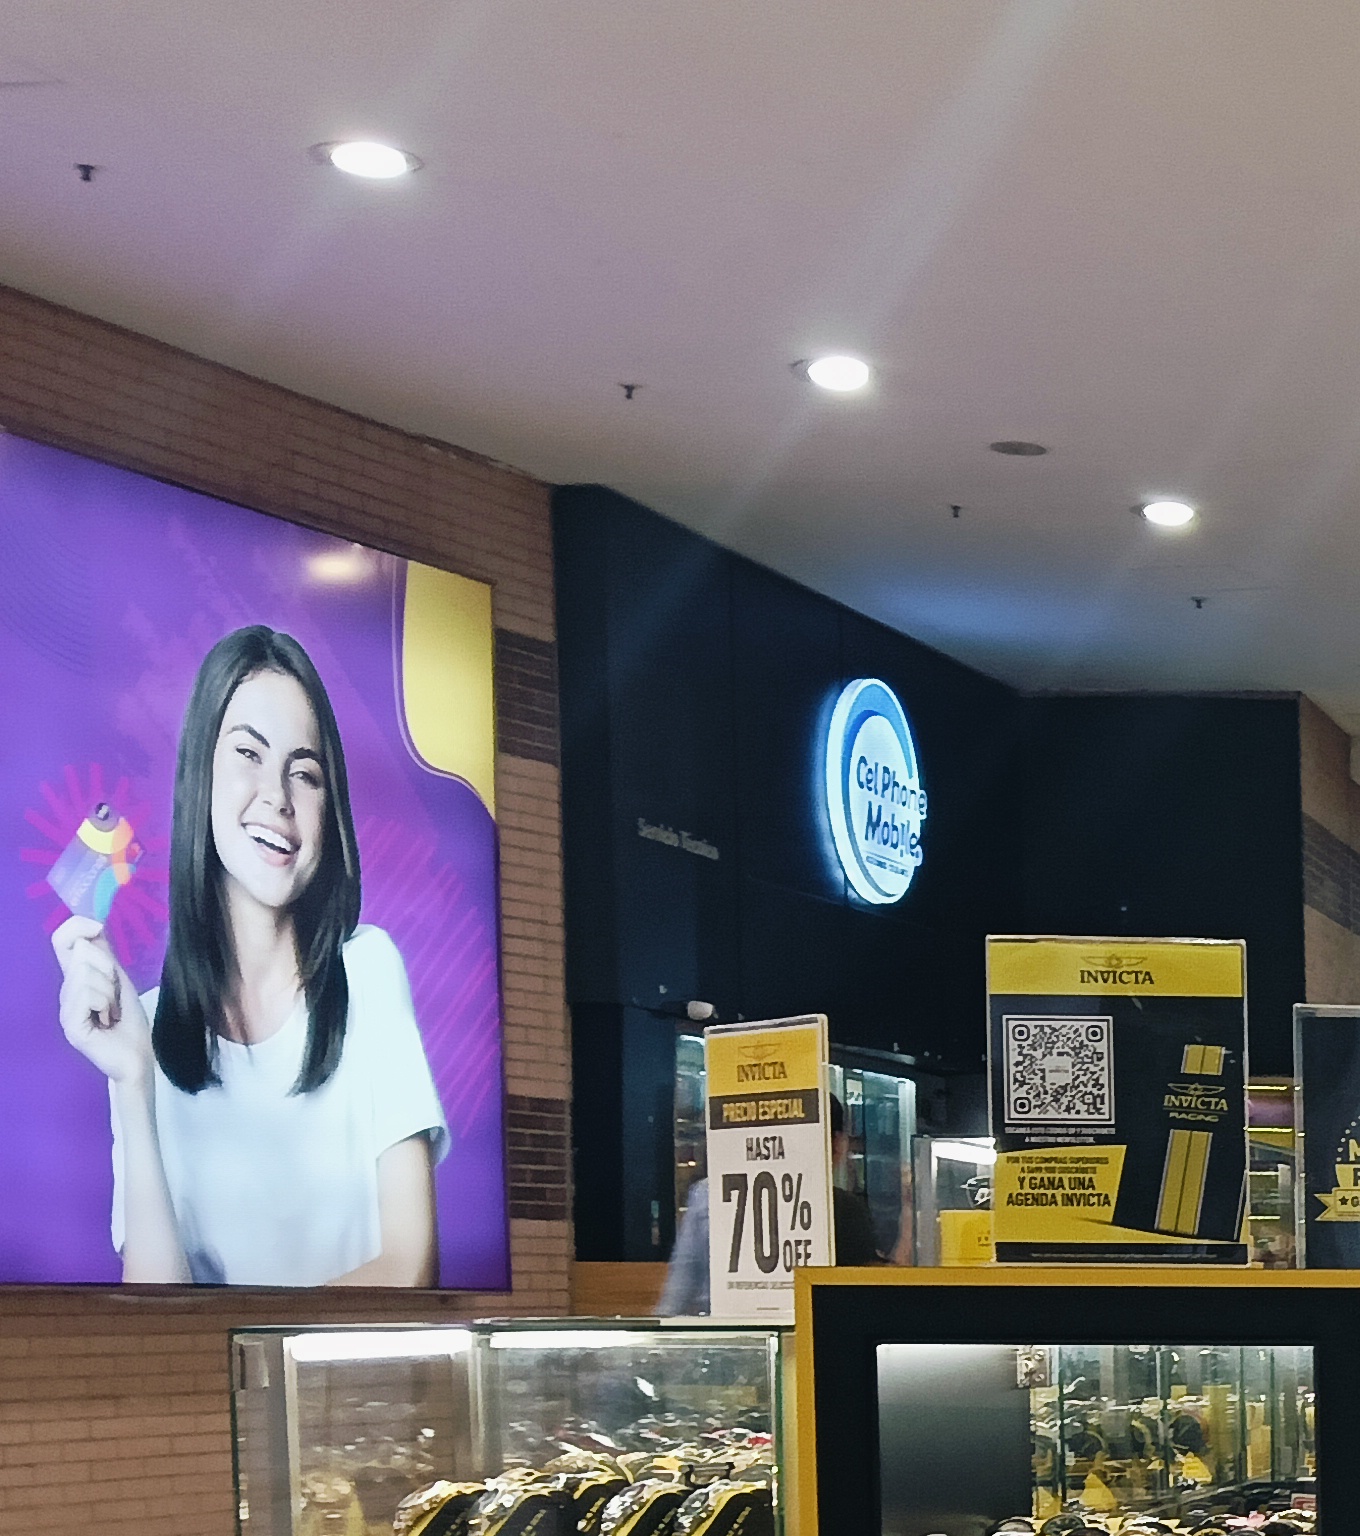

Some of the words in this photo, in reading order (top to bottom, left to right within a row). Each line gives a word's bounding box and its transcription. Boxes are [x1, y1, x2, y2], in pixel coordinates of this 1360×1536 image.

[857, 756, 878, 795] Cel
[881, 766, 928, 815] Phone
[1079, 969, 1154, 985] INVICTA
[737, 1062, 787, 1082] INVICTA
[723, 1101, 757, 1123] PRECIO
[759, 1098, 805, 1120] ESPECIAL
[1163, 1095, 1228, 1111] INVICTA
[746, 1136, 785, 1161] HASTA
[1017, 1176, 1026, 1190] Y
[1029, 1176, 1066, 1190] GANA
[1068, 1176, 1096, 1190] UNA
[1006, 1193, 1058, 1207] AGENDA
[1061, 1193, 1111, 1207] INVICTA
[722, 1171, 812, 1273] 70%
[783, 1239, 812, 1272] OFF
